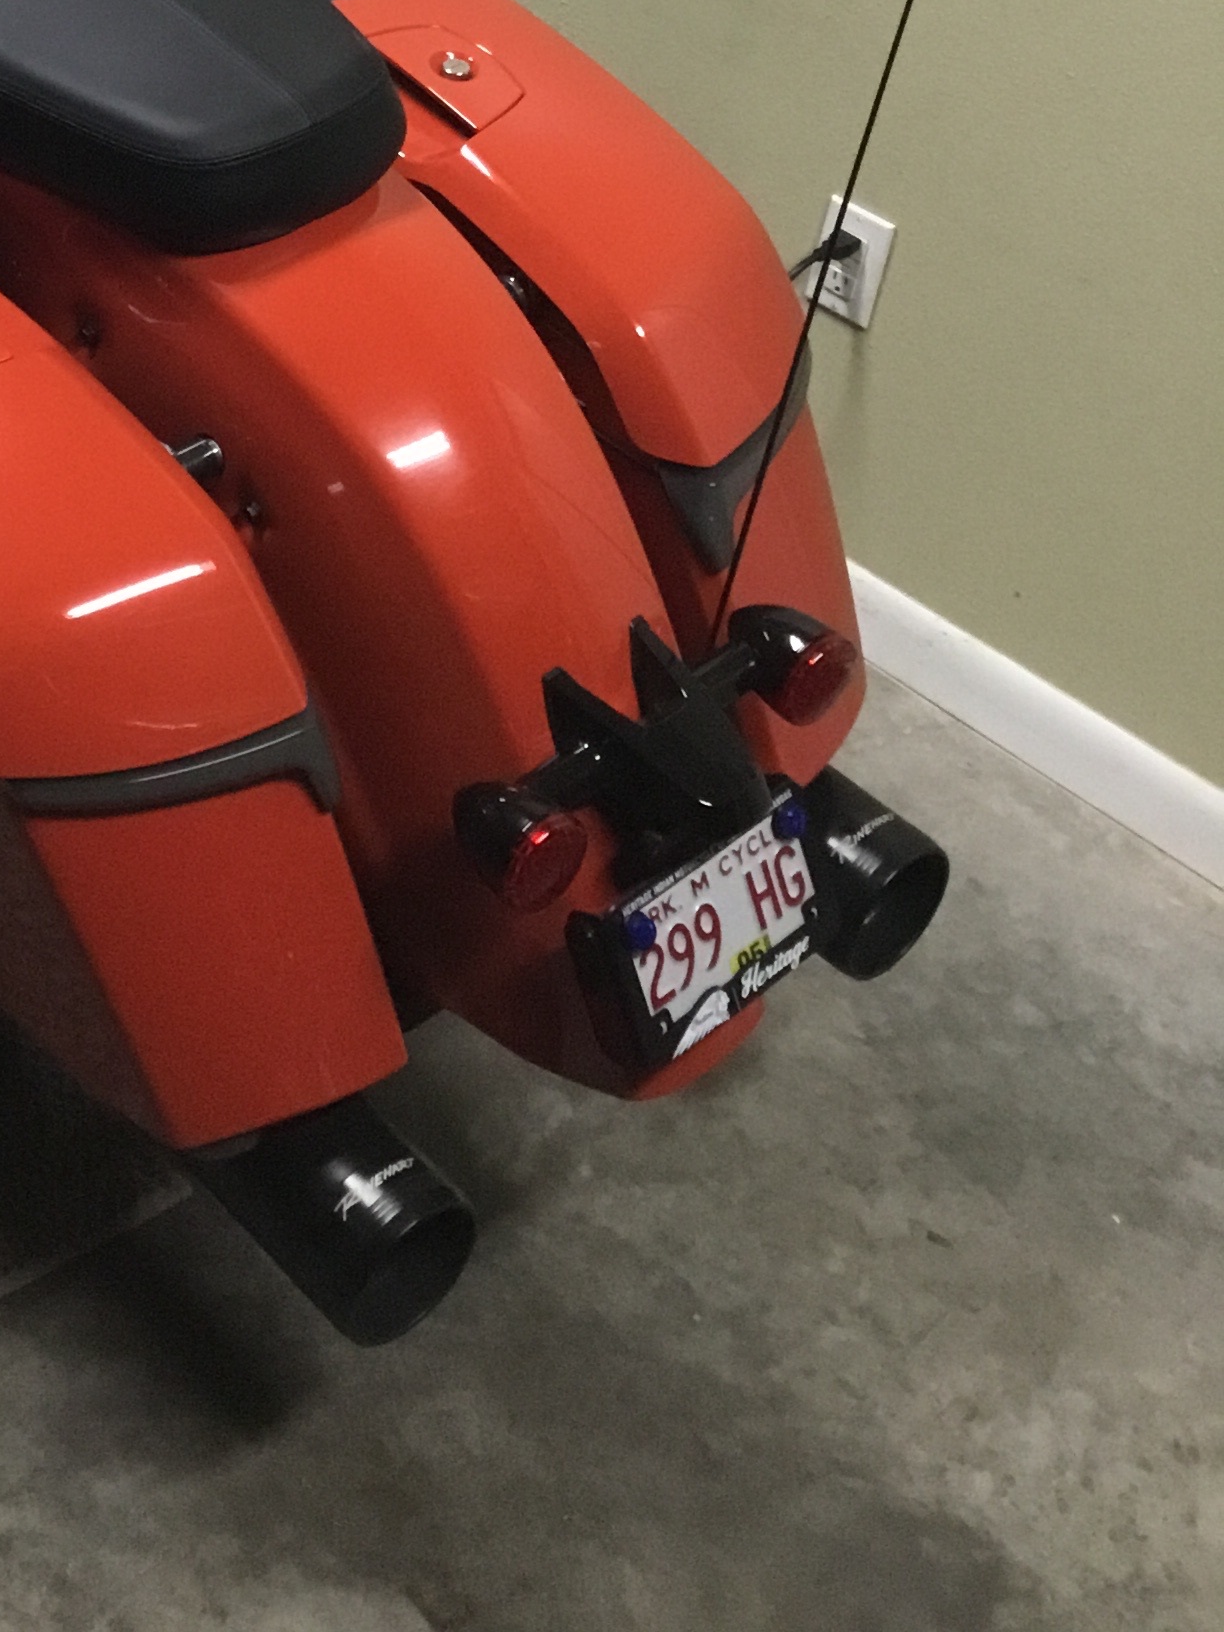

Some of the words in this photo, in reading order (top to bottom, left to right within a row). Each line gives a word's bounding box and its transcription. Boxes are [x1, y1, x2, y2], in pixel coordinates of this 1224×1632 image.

[689, 871, 711, 897] M
[718, 829, 772, 877] CYCL
[639, 903, 722, 1012] 299
[745, 844, 806, 930] HG
[741, 935, 810, 998] Heritage
